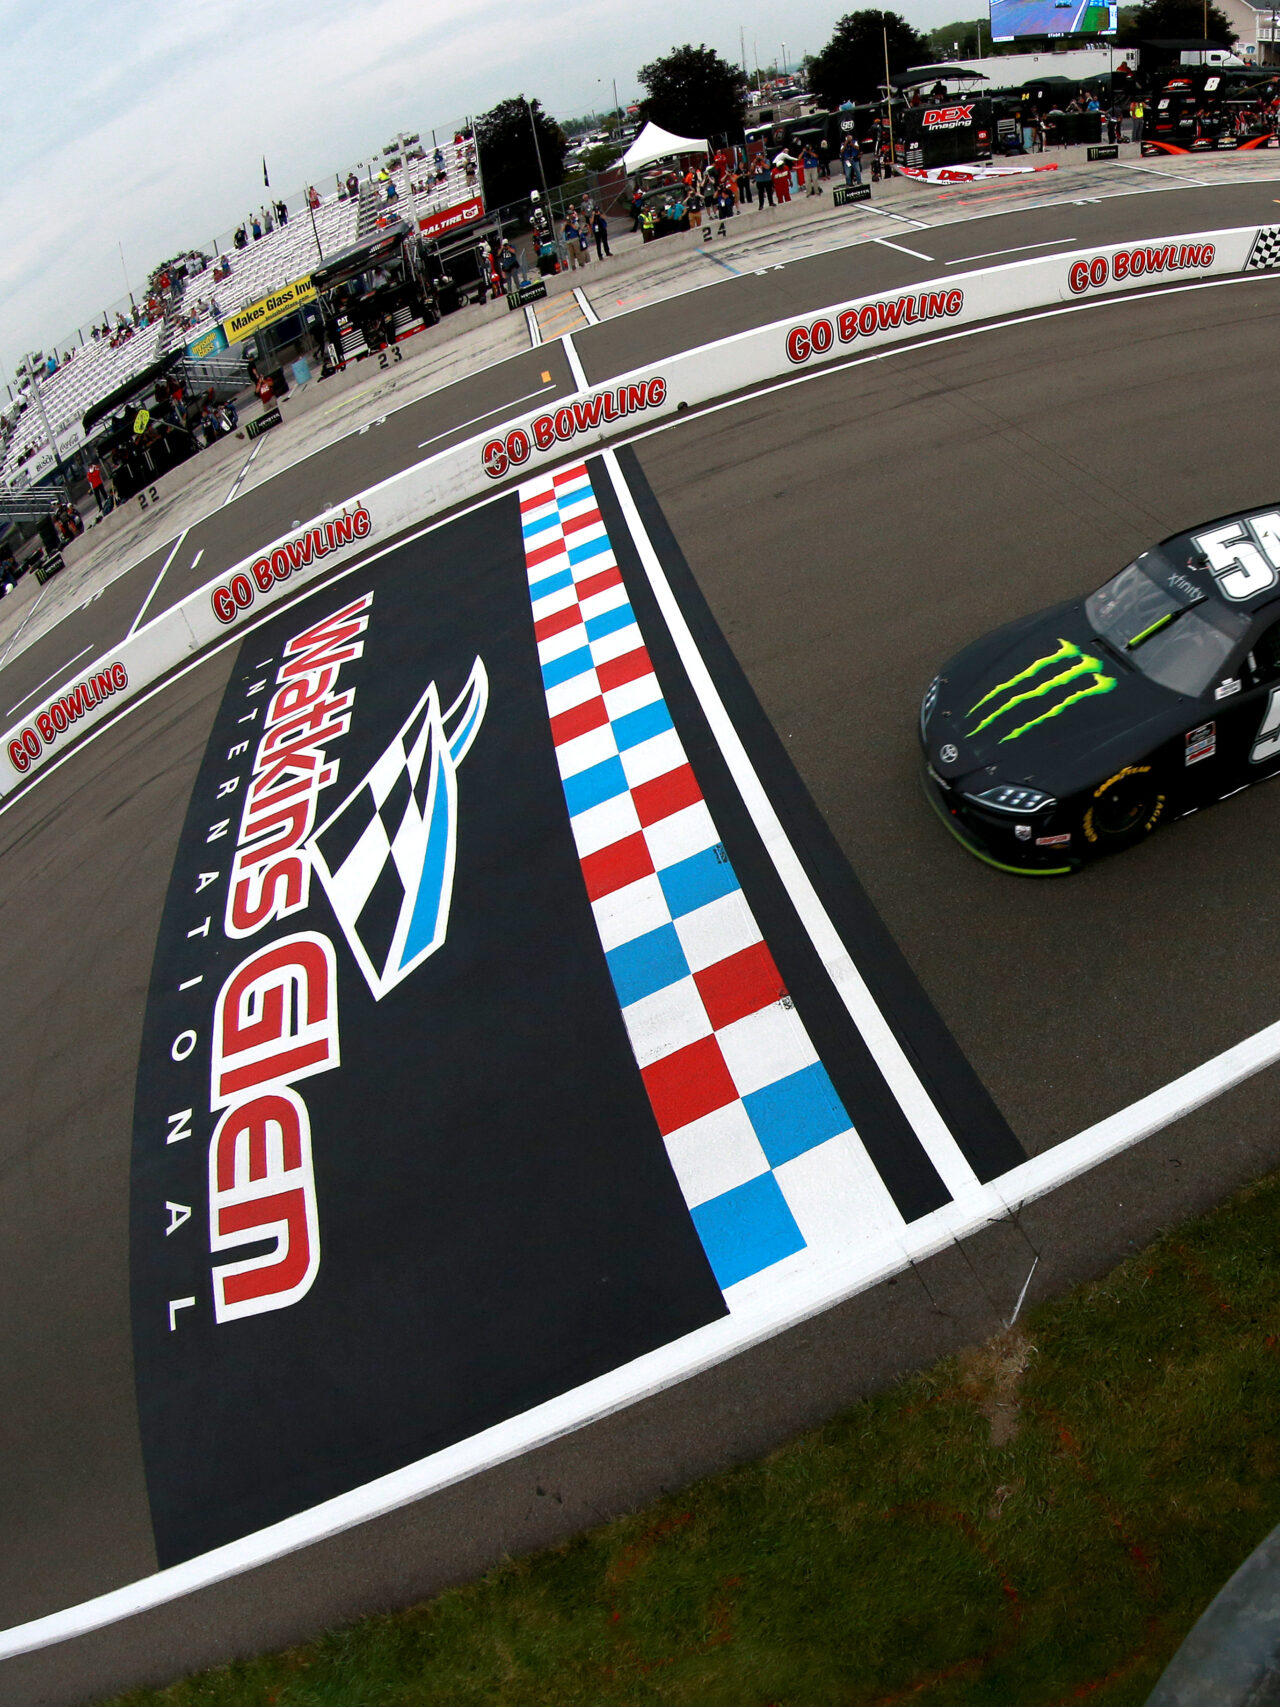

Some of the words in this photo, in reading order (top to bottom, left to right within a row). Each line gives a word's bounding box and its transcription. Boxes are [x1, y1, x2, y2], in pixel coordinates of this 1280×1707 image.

[922, 103, 976, 127] DEX
[702, 221, 728, 242] 24
[1068, 255, 1109, 295] GO
[1111, 242, 1216, 281] BOWLING
[231, 306, 266, 333] Makes
[265, 289, 295, 316] Glass
[785, 318, 834, 364] GO
[835, 288, 964, 344] BOWLING
[481, 427, 531, 479] GO
[530, 375, 667, 451] BOWLING
[138, 486, 160, 510] 22
[211, 573, 254, 623] GO
[250, 508, 371, 592] BOWLING
[1167, 571, 1209, 604] xfinity
[7, 728, 42, 773] GO
[37, 661, 129, 745] BOWLING
[164, 657, 274, 1332] INTERNATIONAL
